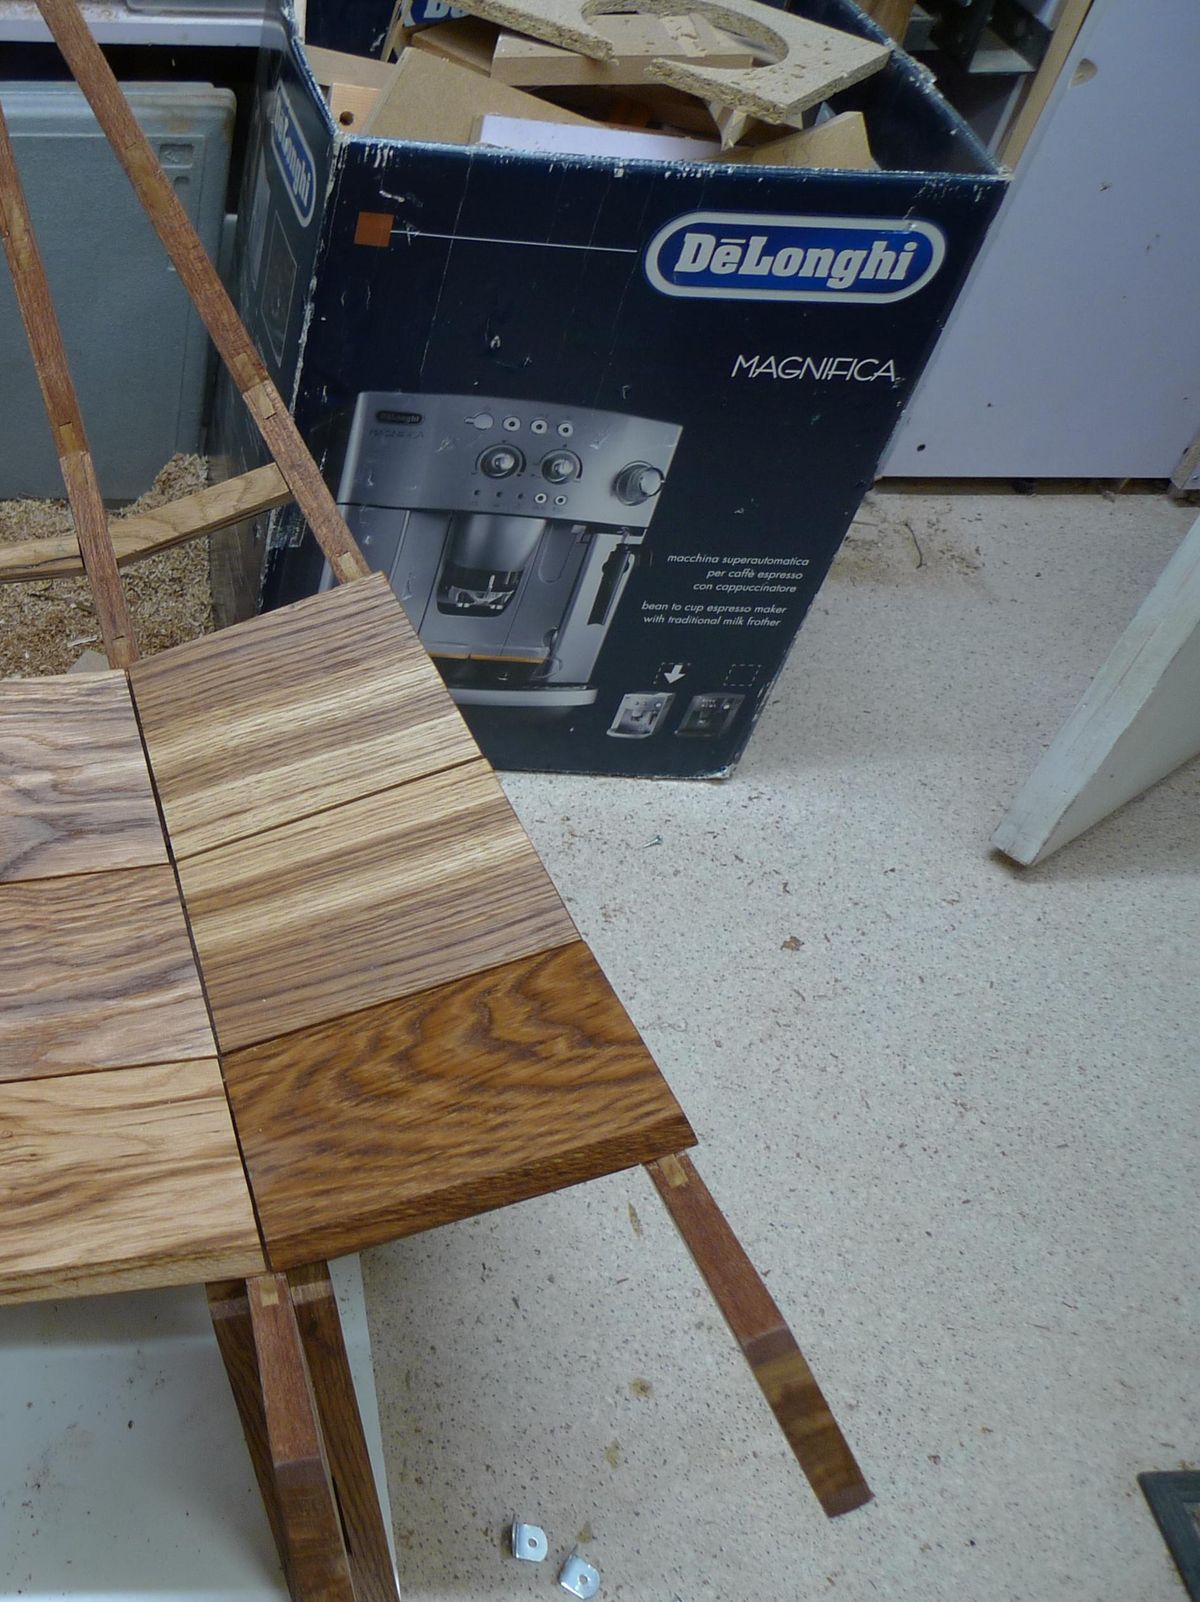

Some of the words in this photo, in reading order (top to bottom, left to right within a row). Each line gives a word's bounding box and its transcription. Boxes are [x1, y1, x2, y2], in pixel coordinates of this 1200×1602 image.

[731, 354, 896, 382] MAGNIFICA
[667, 553, 719, 563] macchina
[722, 556, 810, 566] superautomatica
[706, 569, 725, 579] per
[757, 571, 803, 580] espresso
[693, 583, 712, 591] con
[715, 583, 797, 593] cappuccinatore
[641, 600, 668, 610] bean
[671, 603, 682, 611] to
[684, 603, 704, 613] cup
[707, 605, 751, 614] espresso
[754, 604, 787, 614] maker
[644, 613, 665, 623] with
[668, 614, 721, 625] traditional
[723, 615, 743, 626] milk
[747, 616, 781, 627] frother
